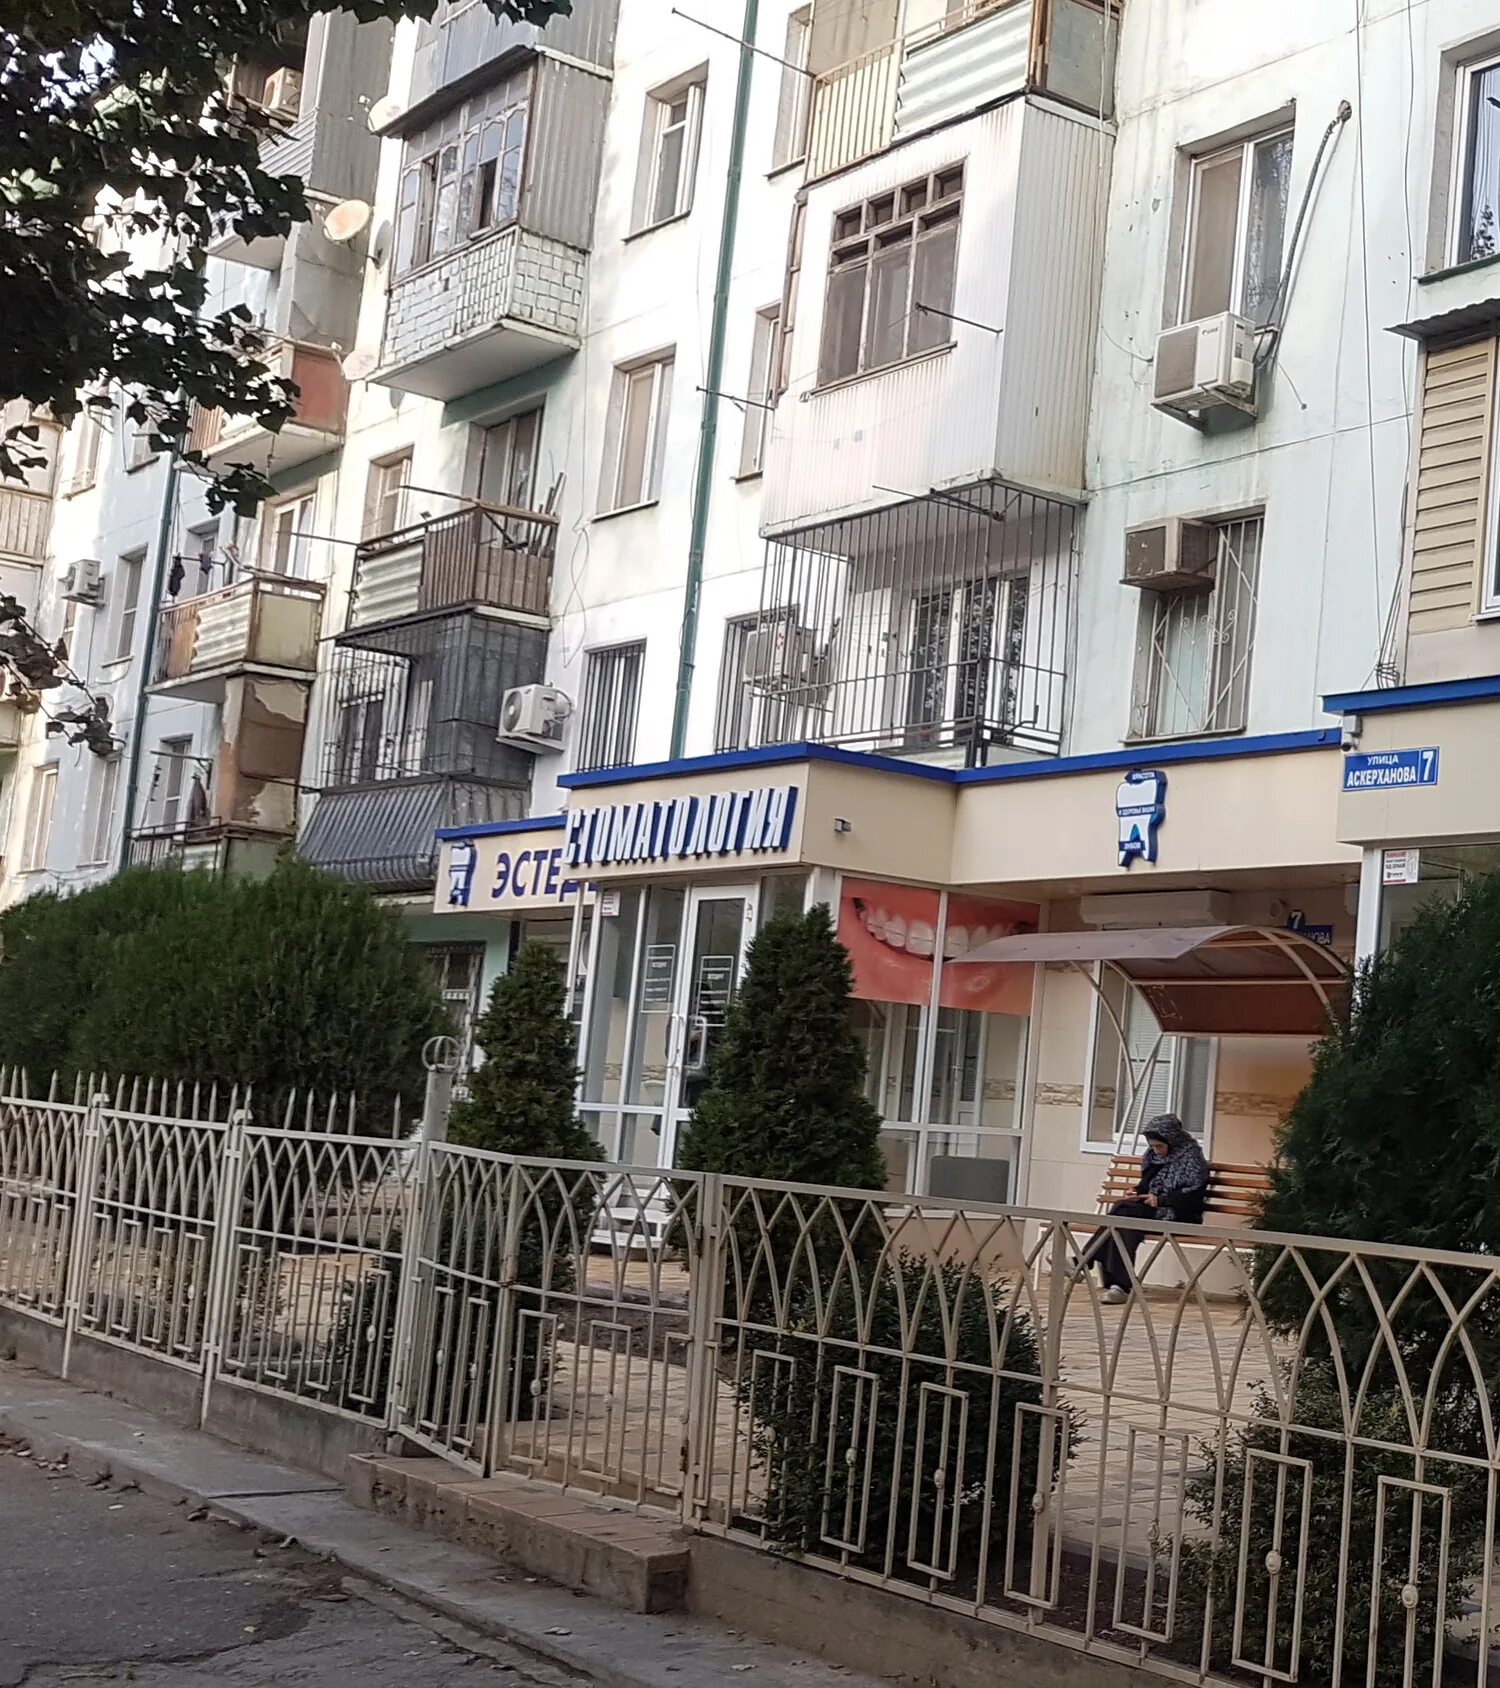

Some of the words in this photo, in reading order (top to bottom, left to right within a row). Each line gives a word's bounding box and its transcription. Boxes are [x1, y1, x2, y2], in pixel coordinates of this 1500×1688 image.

[1367, 754, 1399, 766] УЛИЦА
[1422, 751, 1434, 781] 7
[1347, 766, 1416, 787] АСКЕРХАНОВА
[562, 785, 798, 867] СТОМАТОЛОГИЯ
[491, 848, 597, 902] ЭСТЕ
[1291, 911, 1302, 929] 7
